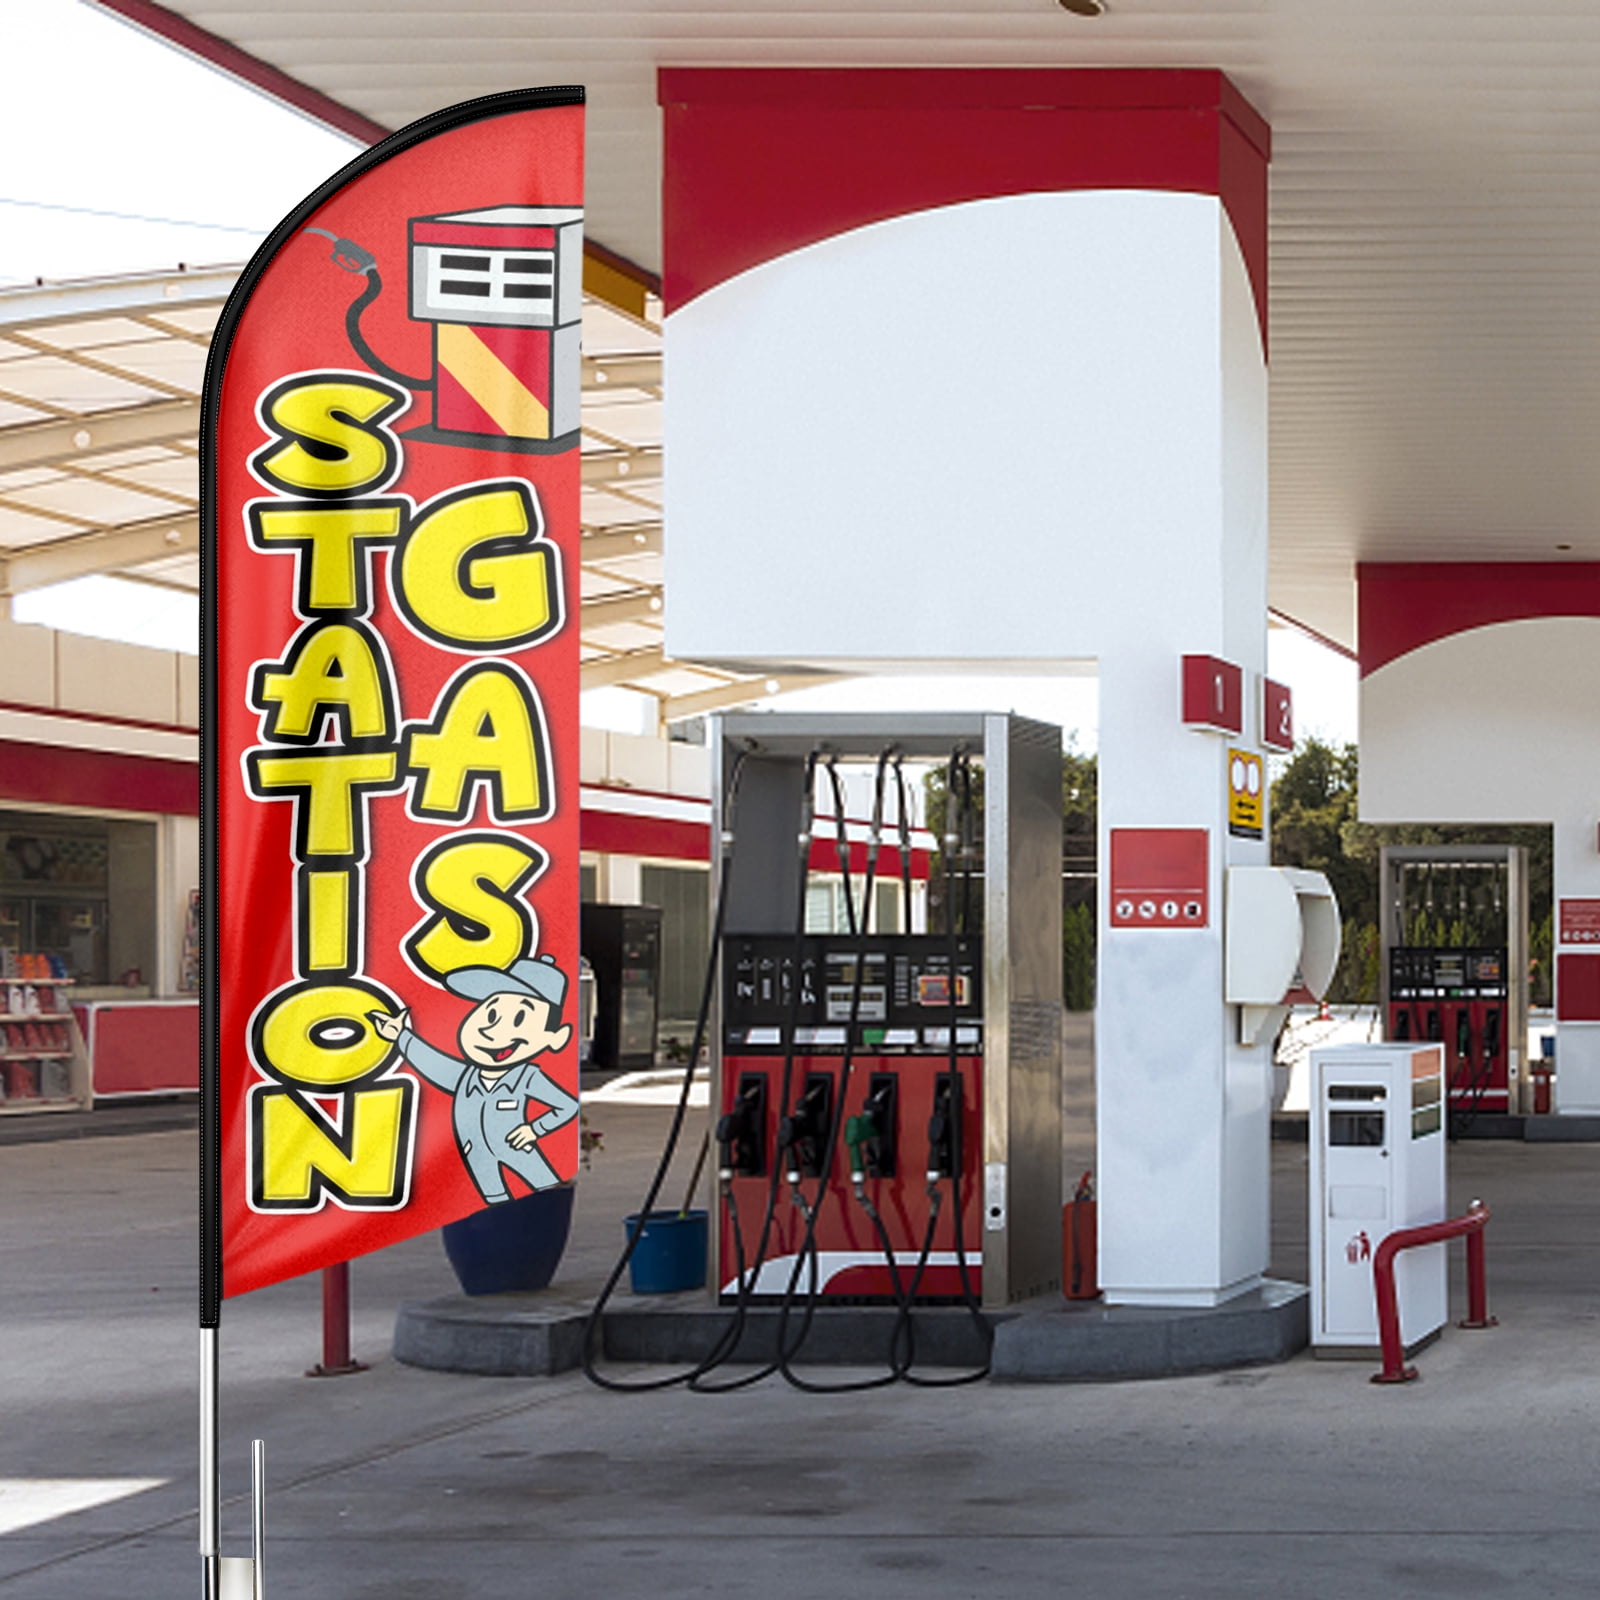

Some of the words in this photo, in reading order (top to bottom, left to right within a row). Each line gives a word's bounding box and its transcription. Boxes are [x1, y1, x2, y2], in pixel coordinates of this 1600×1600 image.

[244, 370, 418, 1213] STATION
[388, 478, 563, 987] GAS
[1214, 674, 1224, 713] 1
